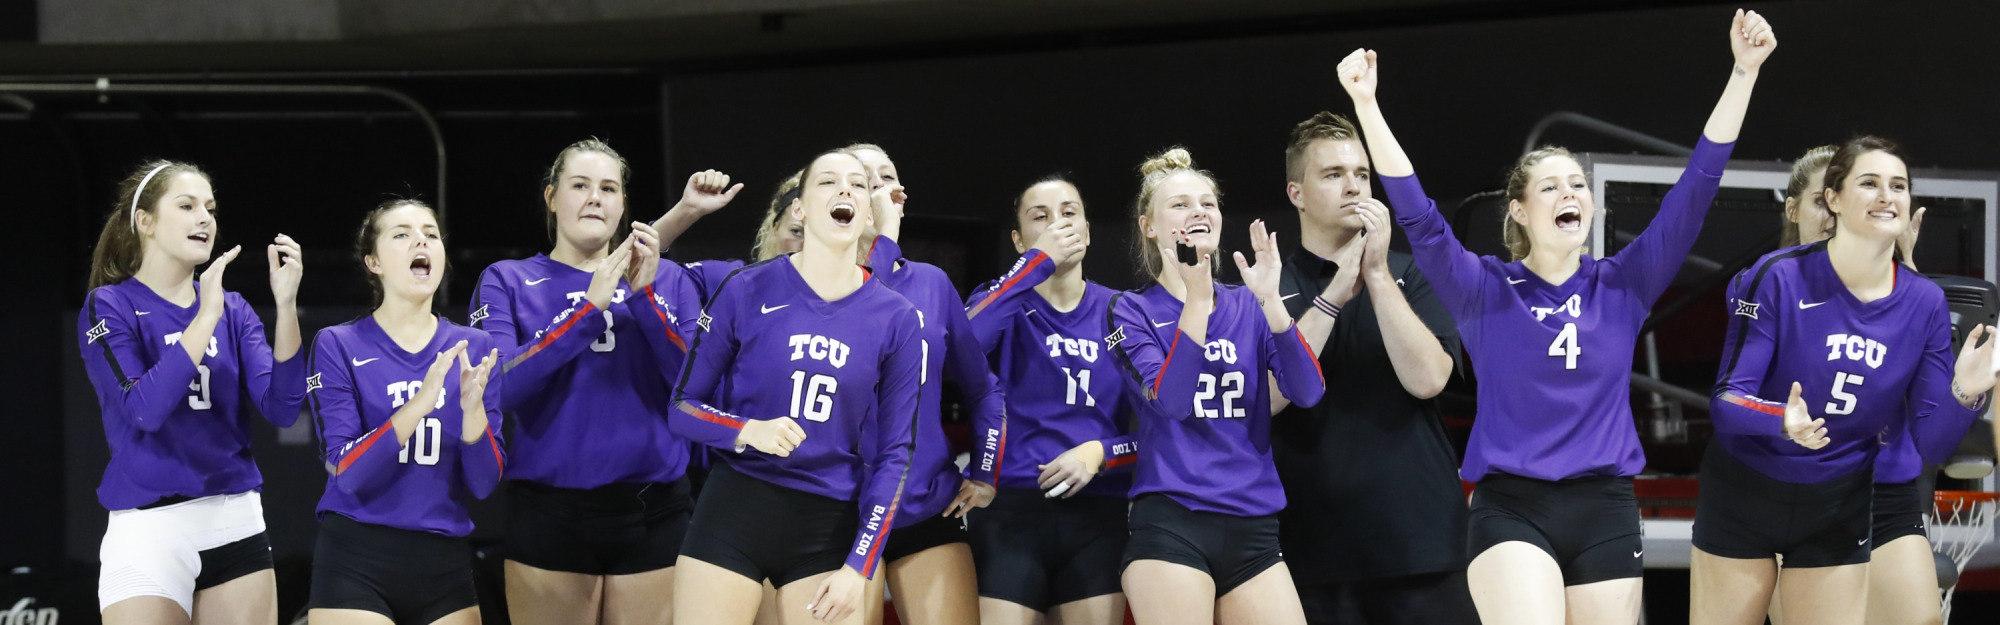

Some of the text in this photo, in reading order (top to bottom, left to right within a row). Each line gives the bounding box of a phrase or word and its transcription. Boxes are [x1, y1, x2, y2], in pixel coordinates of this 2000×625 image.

[1531, 293, 1581, 321] TU
[788, 334, 851, 368] TCU
[1046, 333, 1099, 363] TCU
[1203, 338, 1237, 364] CU
[1548, 322, 1581, 369] 4
[1826, 333, 1887, 369] TCU
[790, 370, 838, 422] 16
[1061, 367, 1096, 407] 11
[1193, 371, 1246, 418] 22
[1825, 371, 1864, 415] 5
[981, 428, 999, 471] BAH ZOO
[855, 505, 886, 556] BAH ZOO
